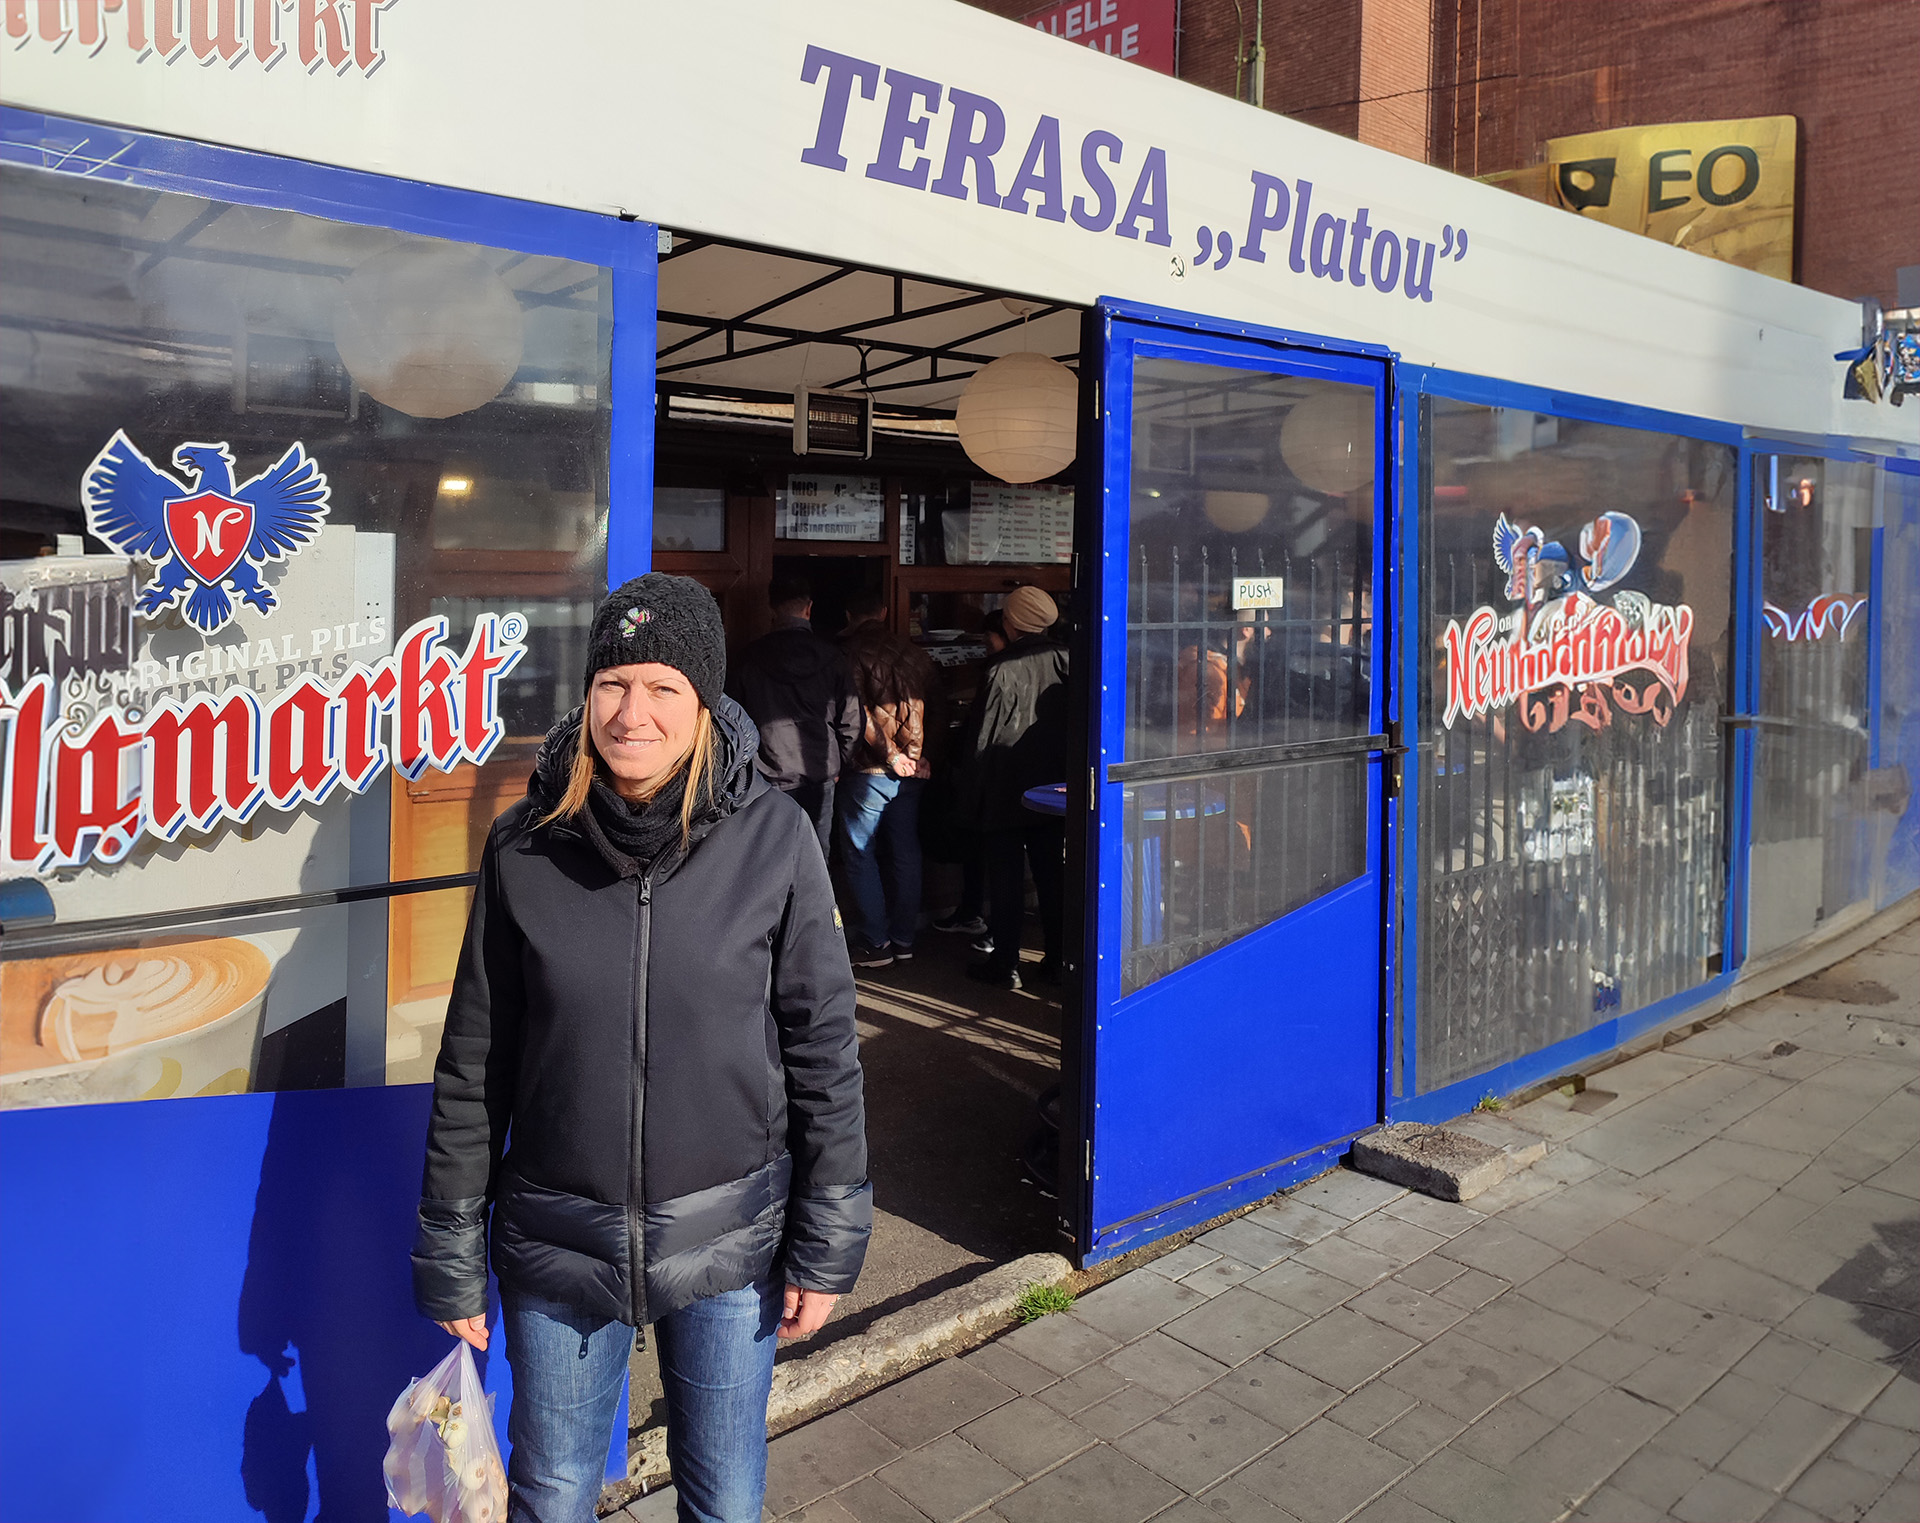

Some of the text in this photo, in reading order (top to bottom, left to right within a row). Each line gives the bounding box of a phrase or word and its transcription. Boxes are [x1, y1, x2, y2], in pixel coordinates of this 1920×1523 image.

[800, 44, 1172, 248] TERASA
[192, 507, 245, 561] N
[1240, 582, 1272, 599] PUSH
[141, 634, 303, 690] RIGINAL
[310, 617, 387, 656] PILS
